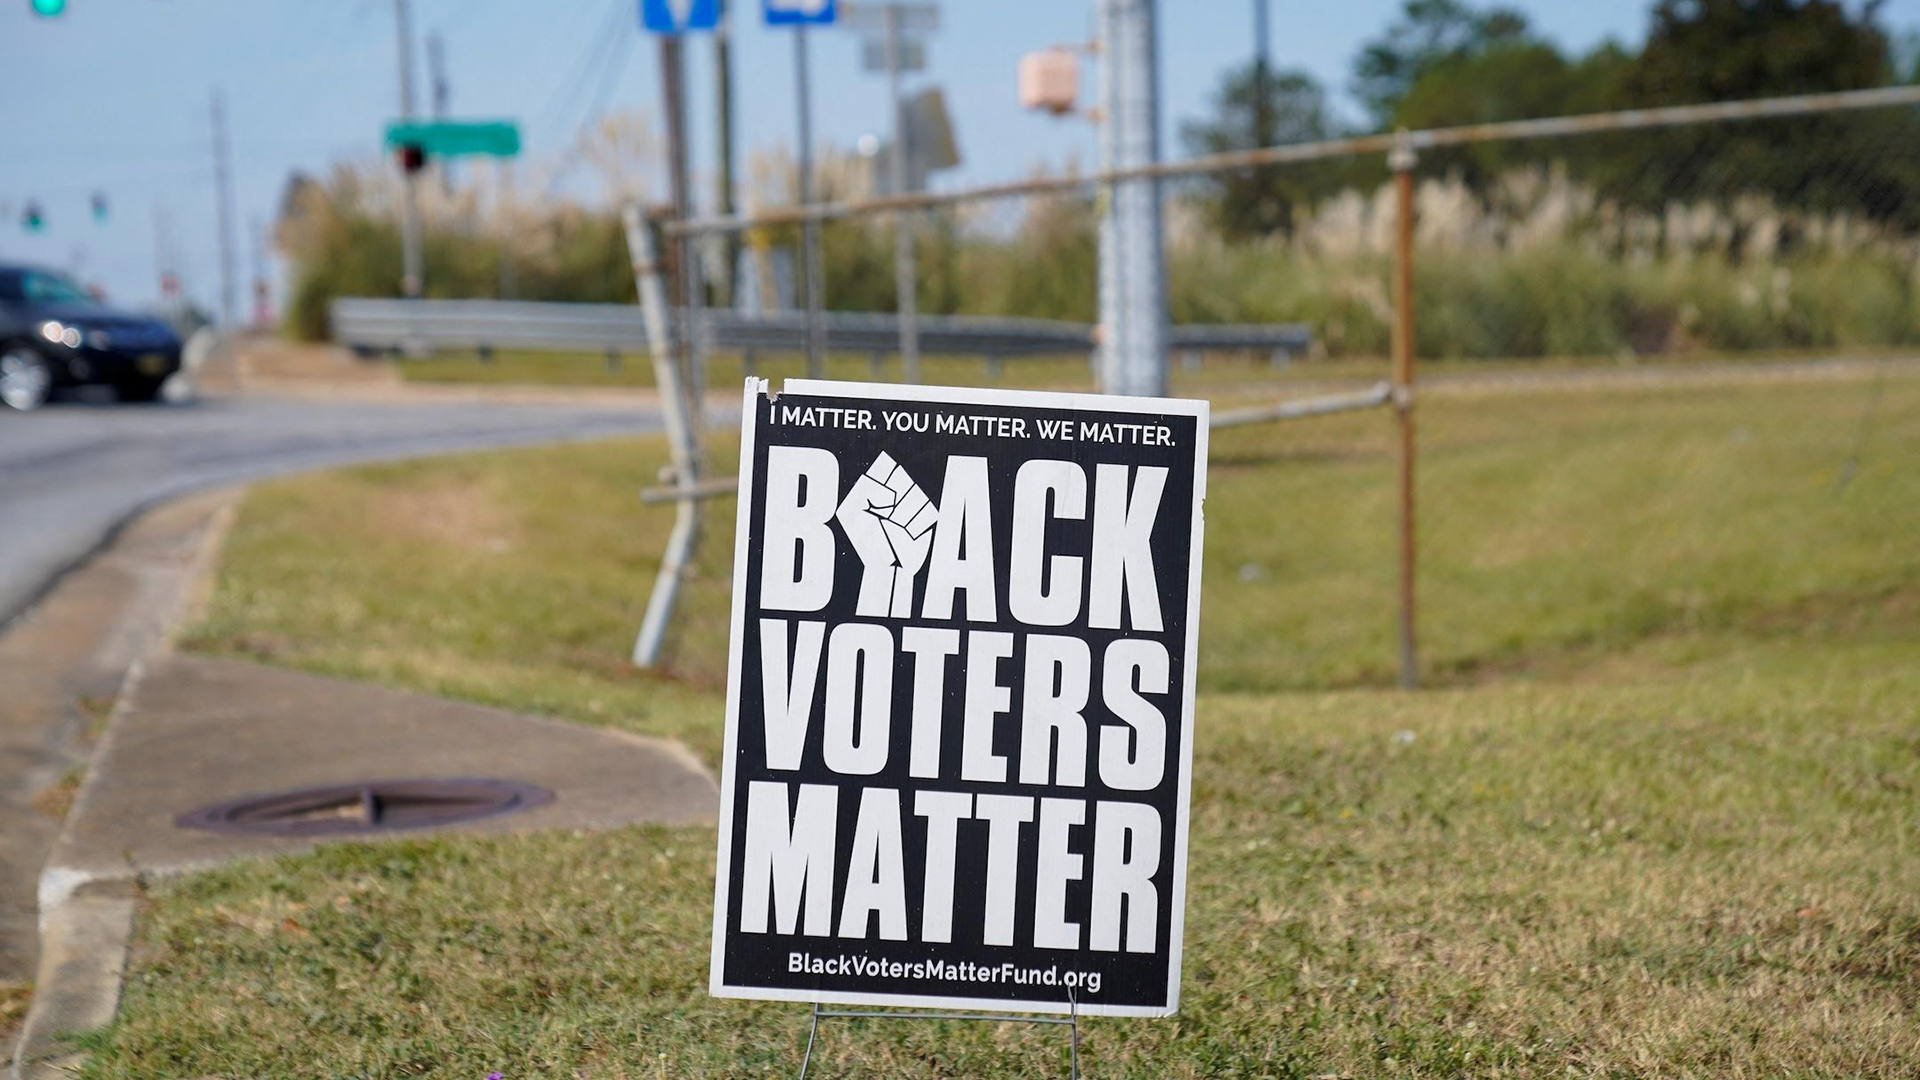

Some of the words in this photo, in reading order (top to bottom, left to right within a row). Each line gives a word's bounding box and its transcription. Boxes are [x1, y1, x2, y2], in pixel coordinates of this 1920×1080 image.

[769, 405, 777, 425] I
[781, 405, 877, 430] MATTER.
[881, 410, 930, 433] YOU
[935, 413, 1031, 439] MATTER.
[1035, 419, 1075, 441] WE
[1079, 421, 1176, 447] MATTER.
[759, 445, 1170, 633] BACK
[759, 617, 1170, 791] VOTERS
[740, 780, 1162, 954] MATTER
[788, 952, 1102, 993] BlackVotersMatterFund.org
